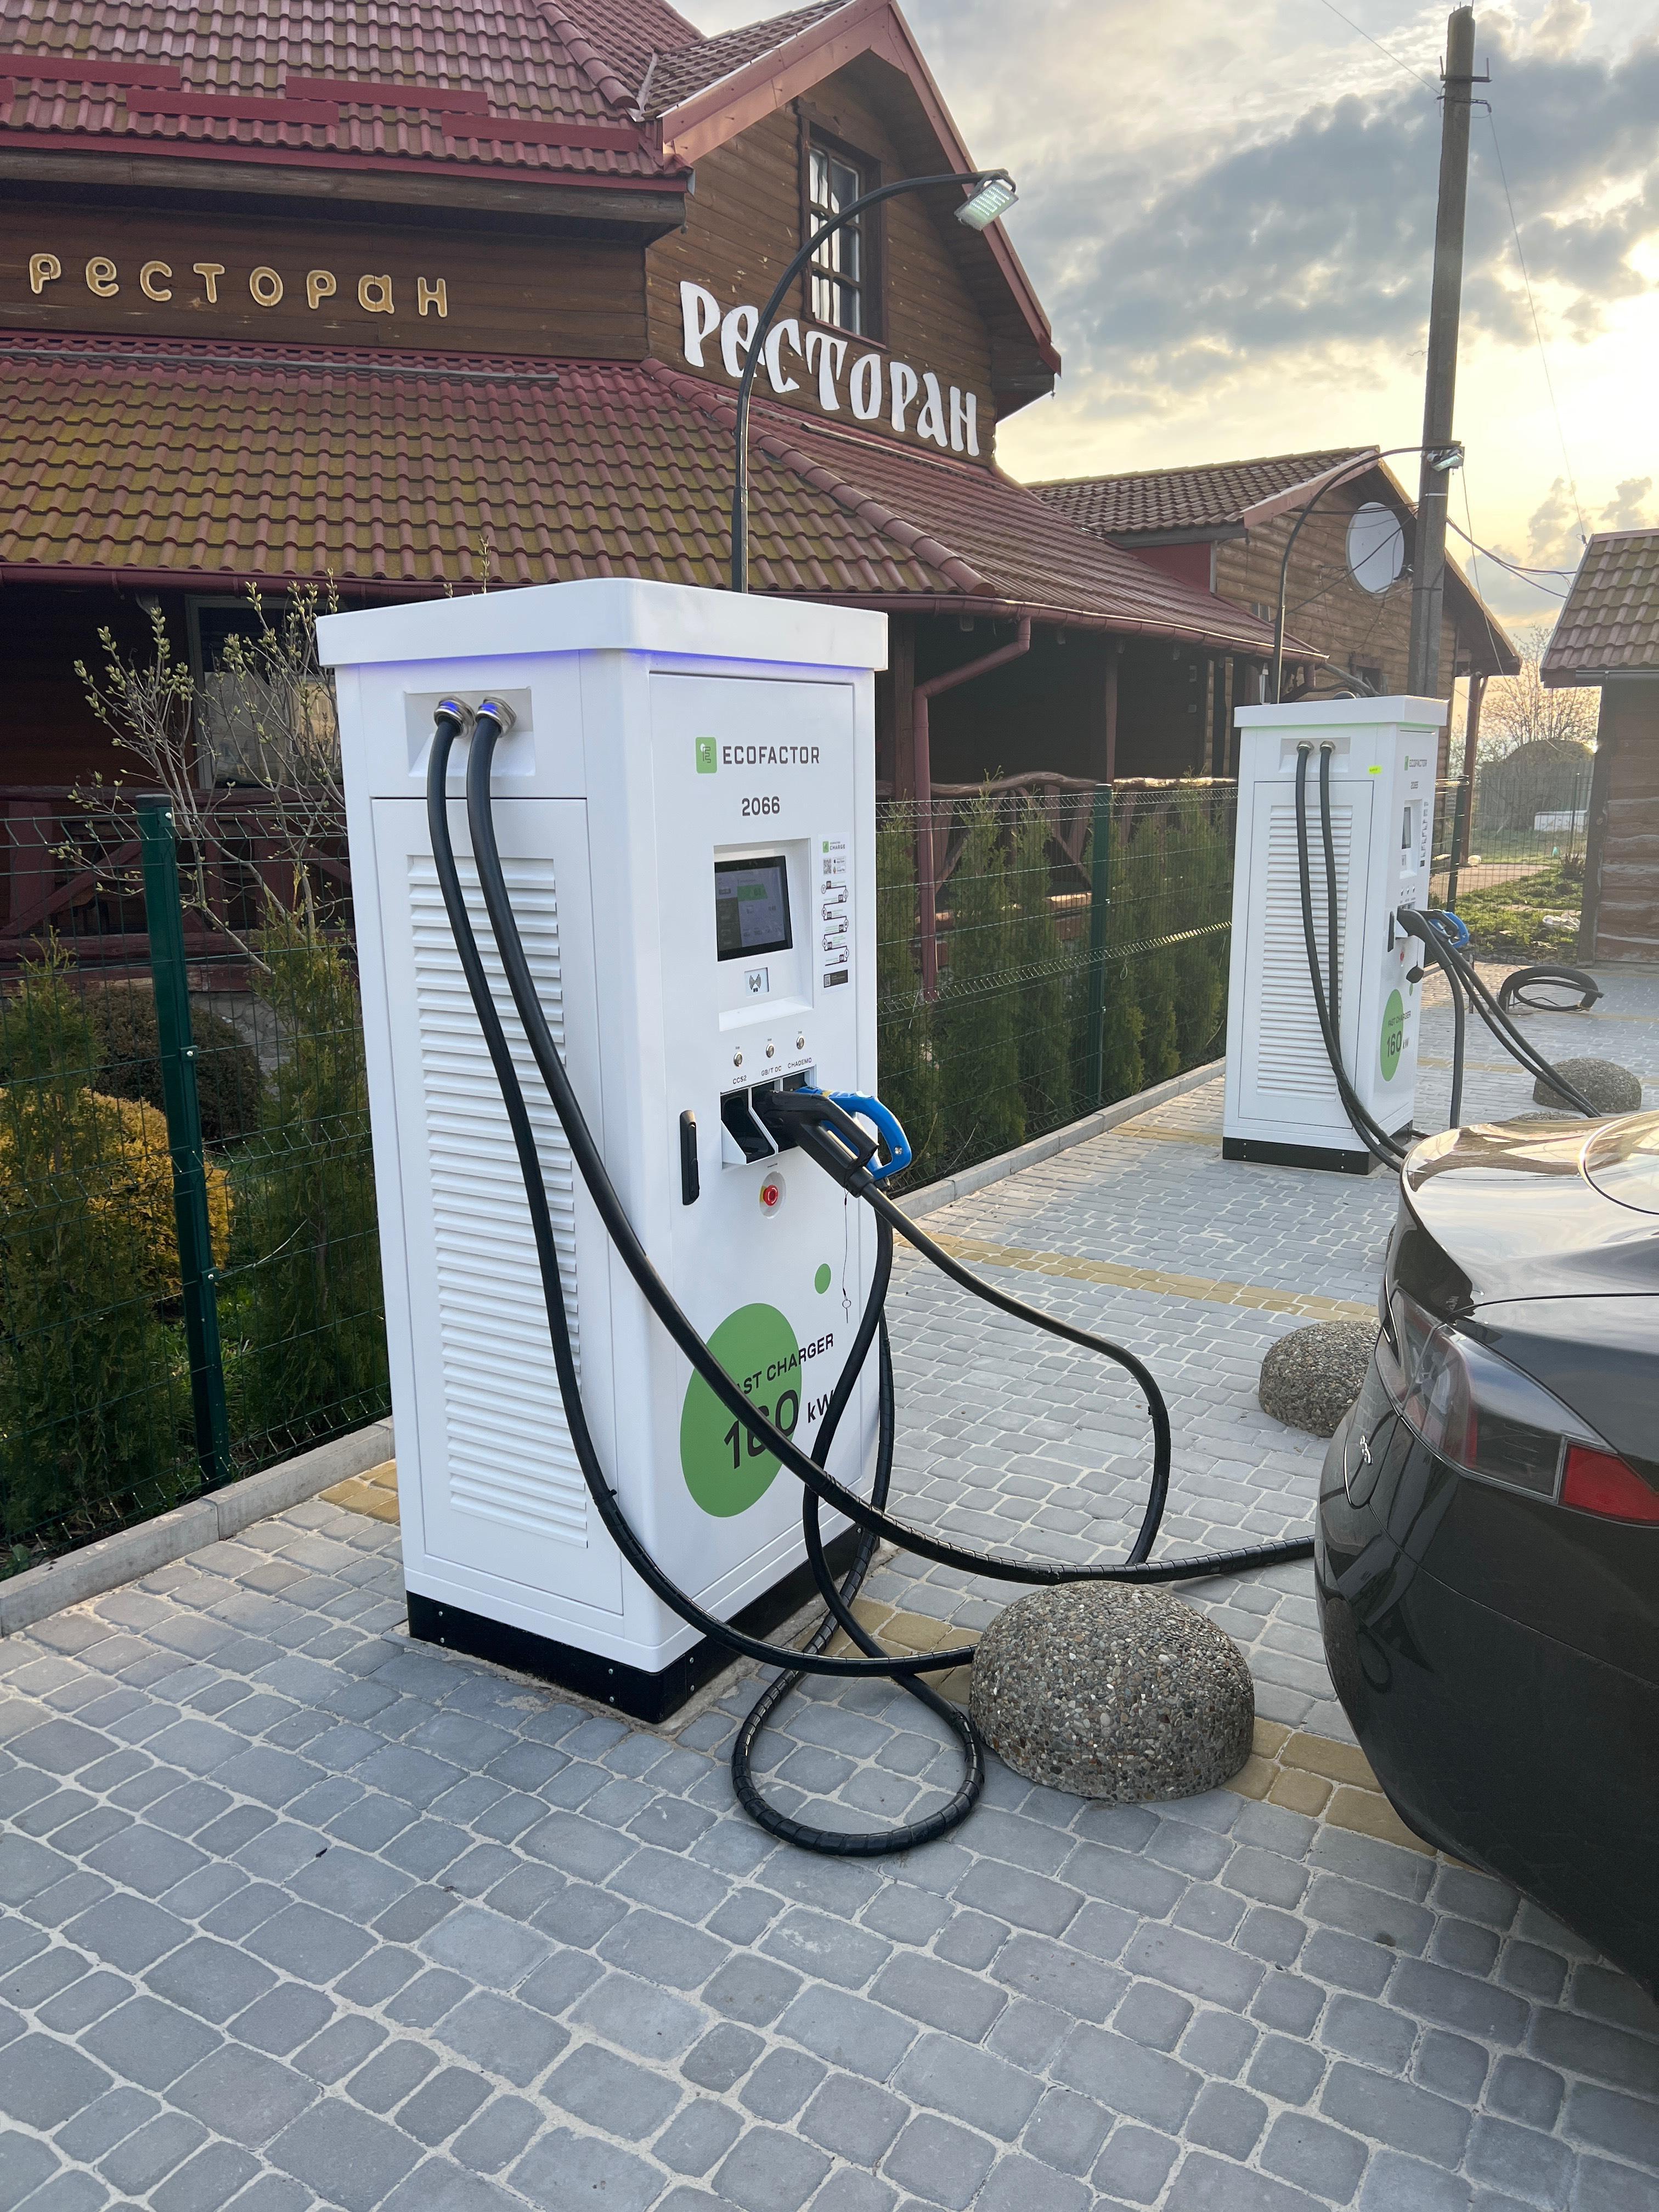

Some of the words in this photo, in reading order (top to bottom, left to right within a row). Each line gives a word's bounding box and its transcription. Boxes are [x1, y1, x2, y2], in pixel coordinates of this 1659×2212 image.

[723, 746, 820, 765] ECOFACTOR
[741, 796, 781, 816] 2066
[1386, 1030, 1402, 1058] 160
[761, 1067, 774, 1076] GB/T
[787, 1057, 812, 1069] CHADEMO
[732, 1075, 747, 1085] CCS2
[766, 1333, 834, 1381] CHARGER
